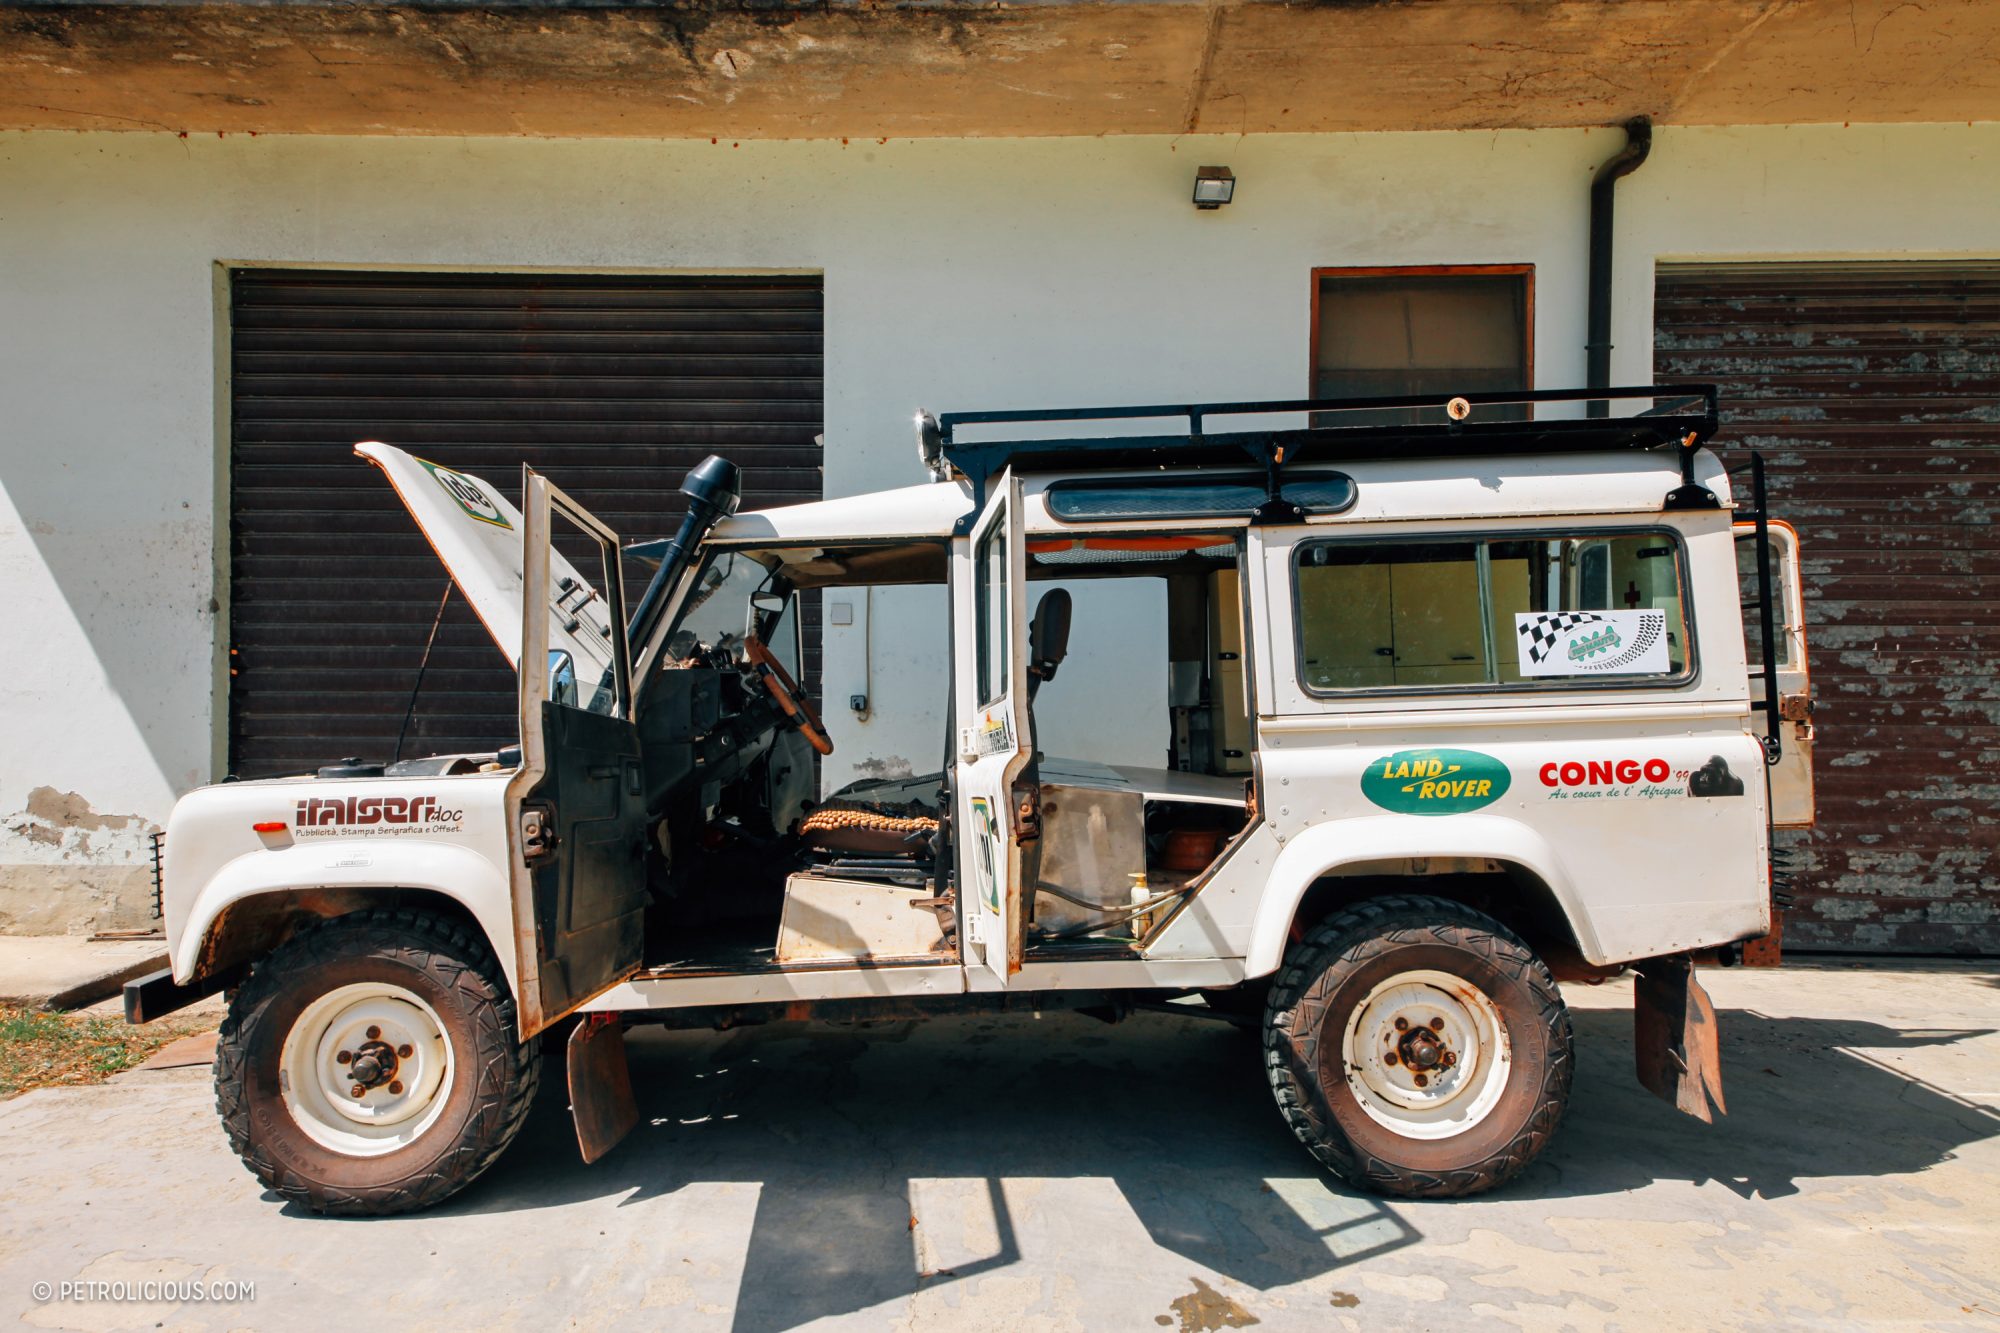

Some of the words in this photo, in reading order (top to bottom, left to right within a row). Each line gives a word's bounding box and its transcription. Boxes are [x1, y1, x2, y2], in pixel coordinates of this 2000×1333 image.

[1383, 760, 1443, 779] LAND
[1539, 758, 1670, 787] CONGO
[1419, 780, 1492, 799] ROVER
[1548, 788, 1568, 800] Au
[1572, 790, 1601, 799] coeur
[1606, 787, 1620, 797] de
[1637, 785, 1684, 797] Afrique
[296, 797, 436, 826] italseri
[430, 805, 463, 823] doc
[341, 828, 375, 837] Stampa
[378, 826, 423, 836] Serigrafica
